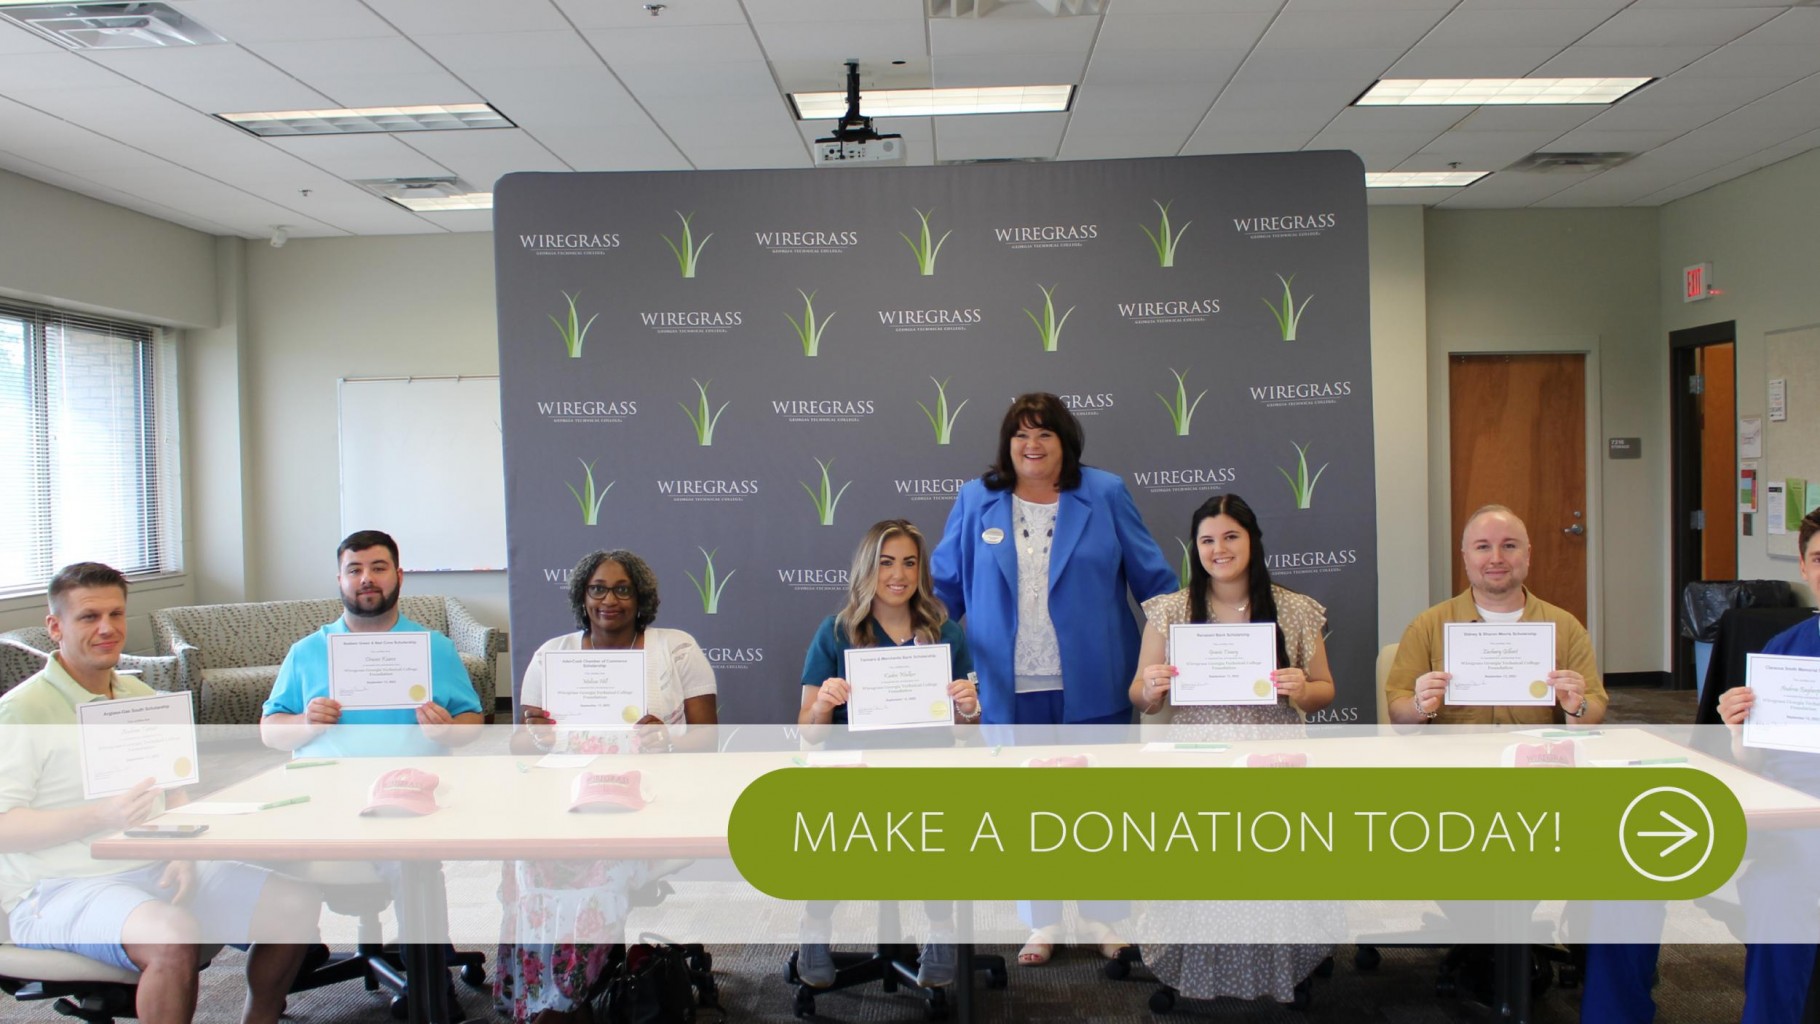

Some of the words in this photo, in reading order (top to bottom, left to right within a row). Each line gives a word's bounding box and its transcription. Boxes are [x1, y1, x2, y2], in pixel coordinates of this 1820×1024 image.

[1234, 214, 1335, 231] WIREGRASS
[520, 234, 619, 247] WIREGRASS
[756, 232, 857, 245] WIREGRASS
[995, 225, 1097, 241] WIREGRASS
[1686, 267, 1702, 297] EXIT
[1118, 300, 1219, 316] WIREGRASS
[641, 312, 741, 325] WIREGRASS
[879, 309, 981, 324] WIREGRASS
[1250, 382, 1350, 399] WIREGRASS
[538, 402, 636, 414] WIREGRASS
[773, 401, 873, 414] WIREGRASS
[1134, 468, 1235, 485] WIREGRASS
[657, 480, 758, 493] WIREGRASS
[894, 478, 965, 493] WIREGR
[777, 569, 849, 583] WIREGR
[704, 647, 763, 662] GRASS
[1305, 707, 1358, 723] GRASS
